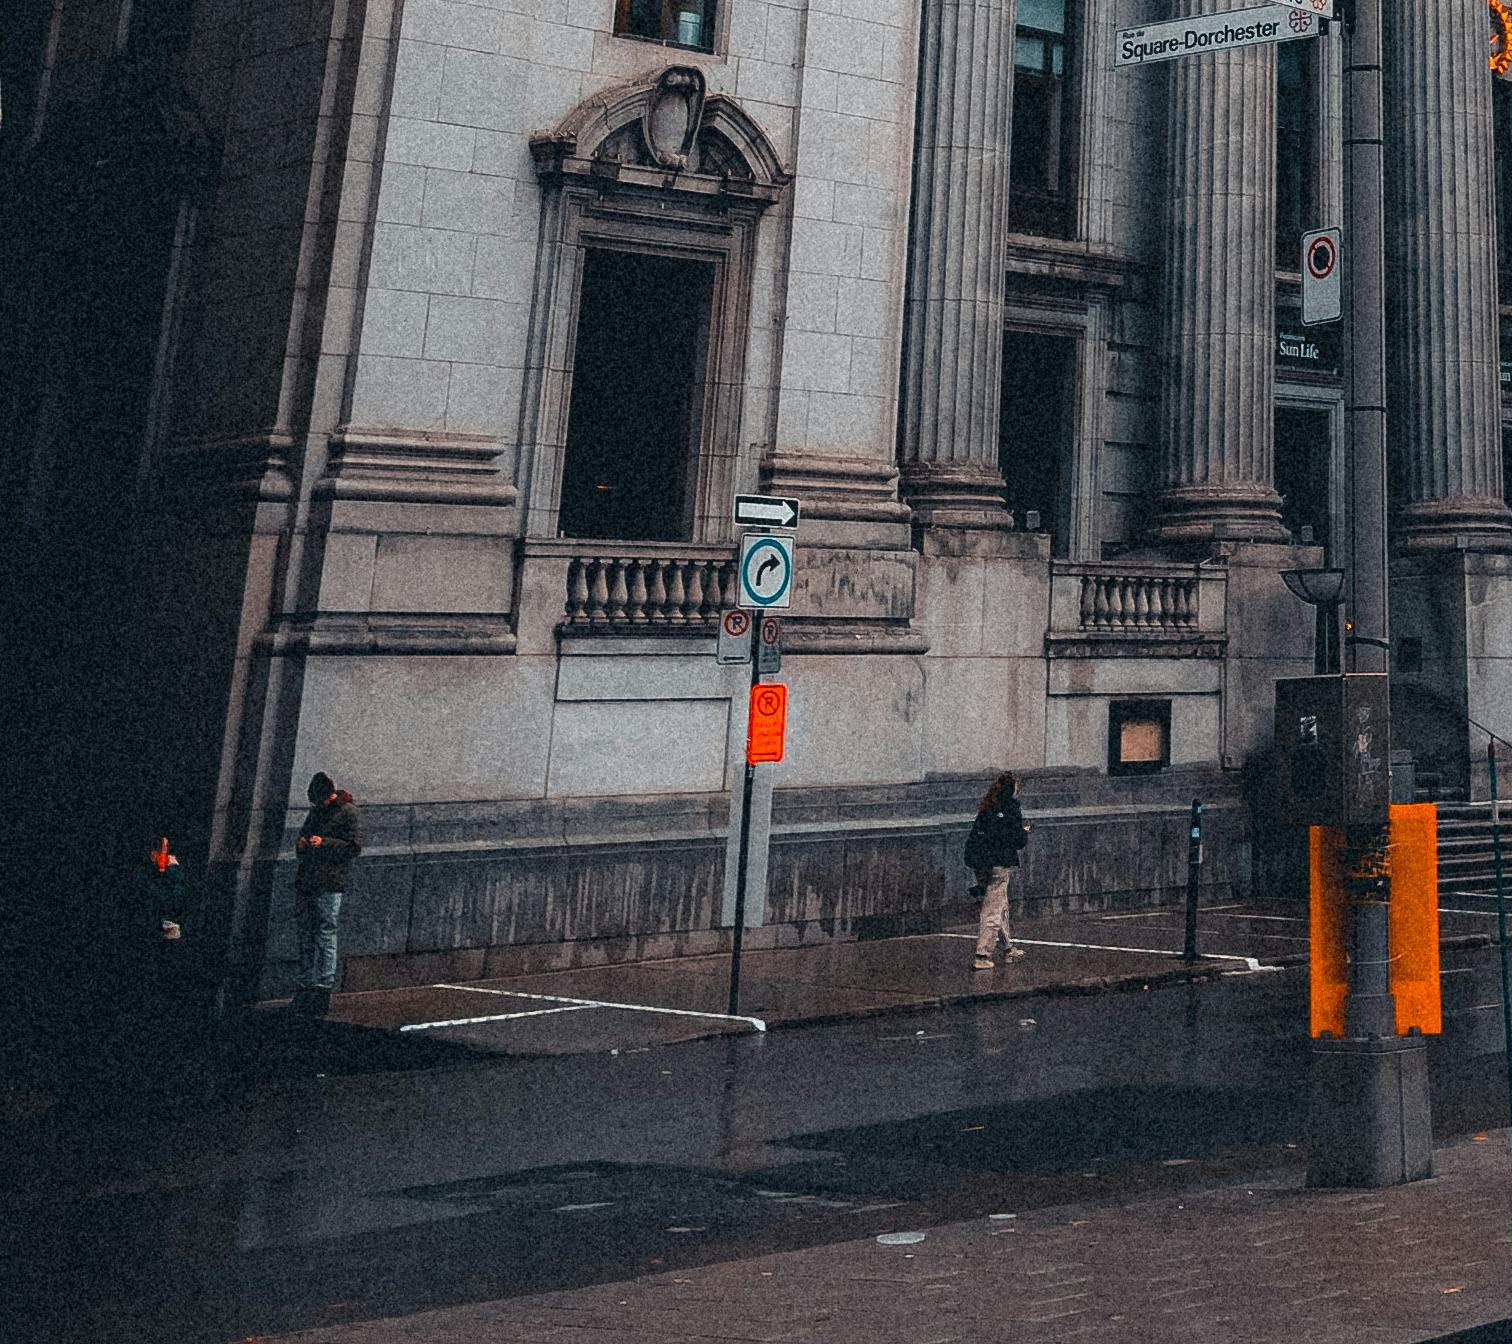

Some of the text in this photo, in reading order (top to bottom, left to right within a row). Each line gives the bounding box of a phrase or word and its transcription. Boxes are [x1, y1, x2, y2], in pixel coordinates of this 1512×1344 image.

[1121, 21, 1280, 62] Square-Dorchester
[1279, 341, 1320, 359] Sun Life
